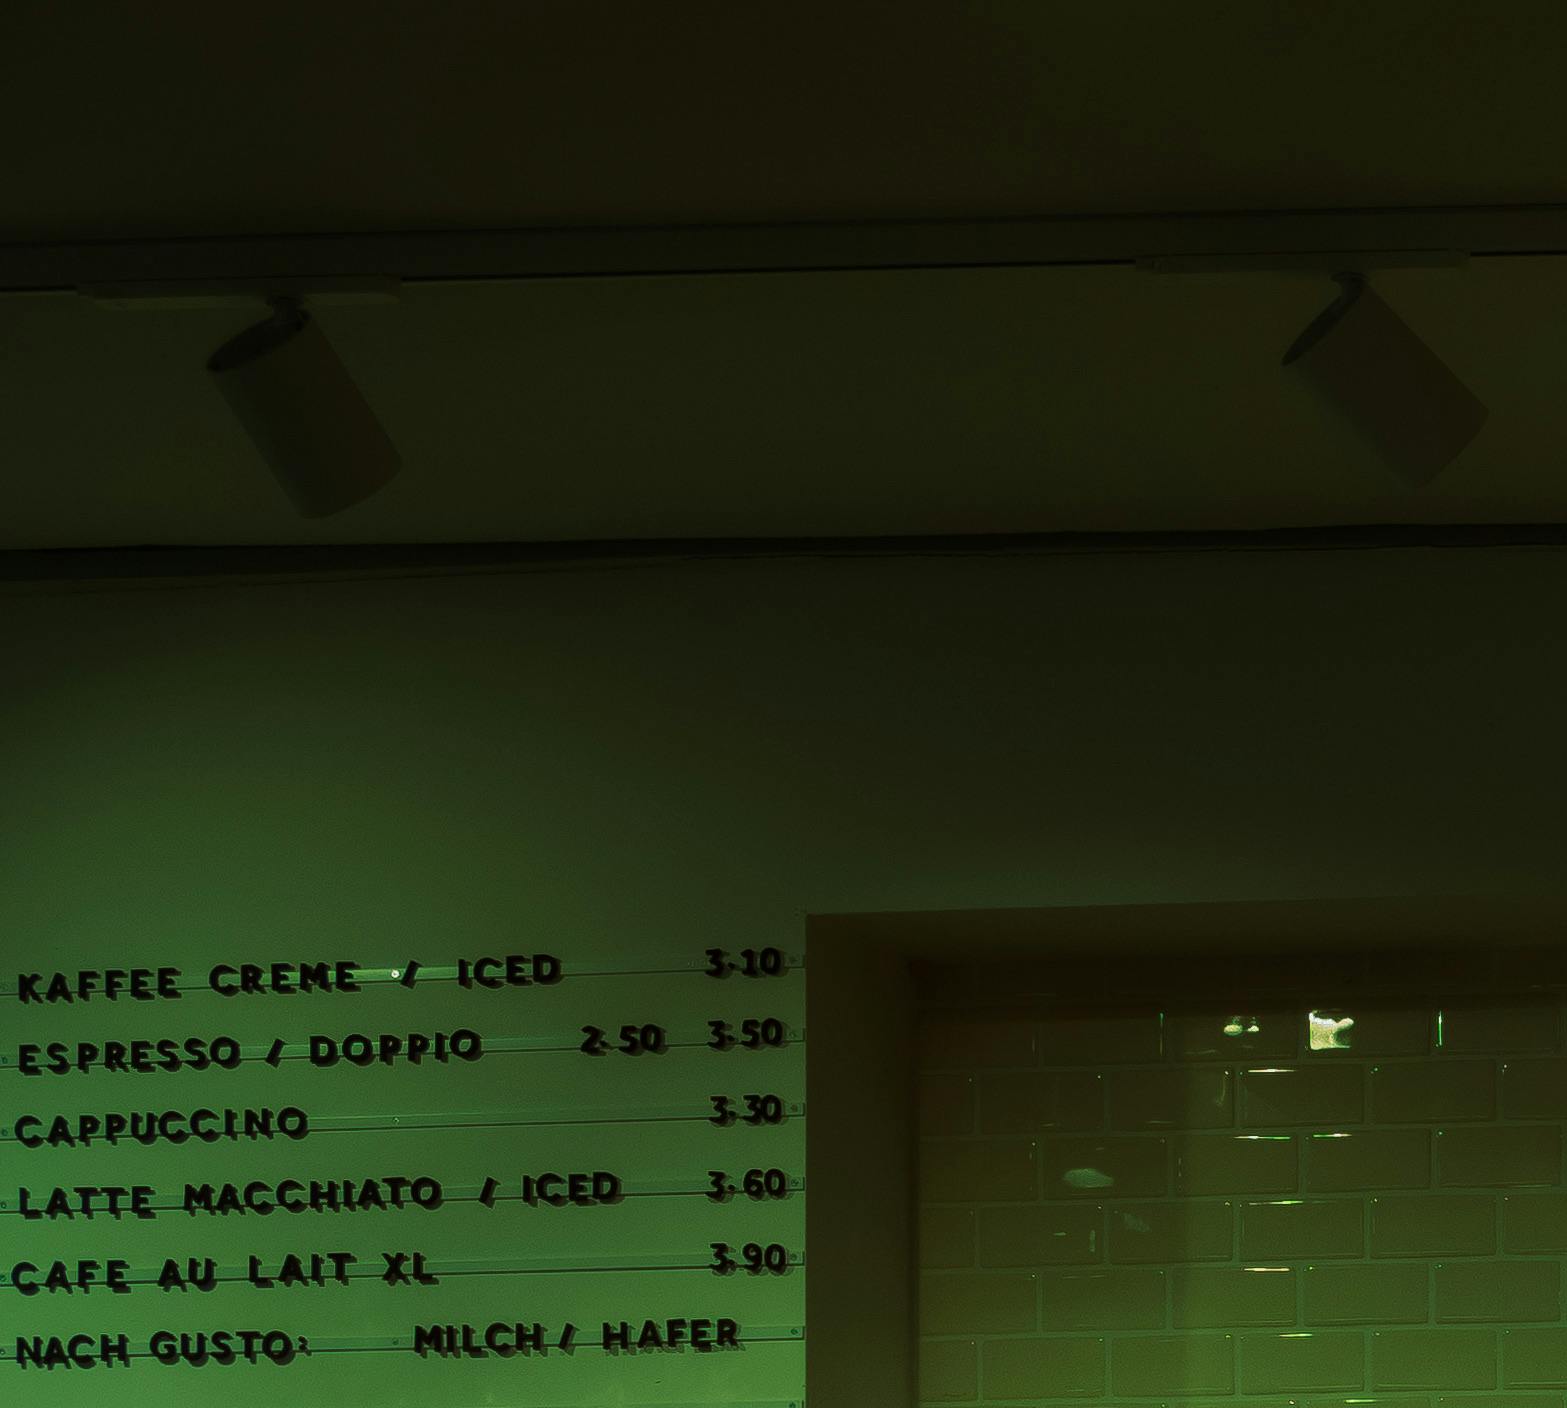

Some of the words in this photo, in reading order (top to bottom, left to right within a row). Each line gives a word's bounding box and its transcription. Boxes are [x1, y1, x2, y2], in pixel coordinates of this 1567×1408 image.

[18, 967, 181, 1002] KAFFEE
[209, 961, 360, 997] CREME
[458, 954, 563, 989] ICED
[18, 1037, 240, 1074] ESPRESSO
[309, 1029, 484, 1066] DOPPIO
[580, 1025, 665, 1056] 2.50
[708, 1018, 785, 1050] 3.50
[14, 1107, 309, 1146] CAPPUCCINO
[709, 1095, 783, 1127] 3.30
[19, 1186, 156, 1220] LATTE
[184, 1178, 442, 1215] MACCHIATO
[522, 1172, 621, 1204] ICED
[706, 1169, 787, 1201] 3.60
[12, 1260, 130, 1295] CAFE
[158, 1259, 216, 1292] AU
[249, 1252, 356, 1287] LAIT
[382, 1252, 438, 1286] XL
[709, 1244, 787, 1277] 3.90
[16, 1334, 128, 1369] NACH
[413, 1323, 545, 1358] MILCH
[602, 1318, 740, 1354] HAFER
